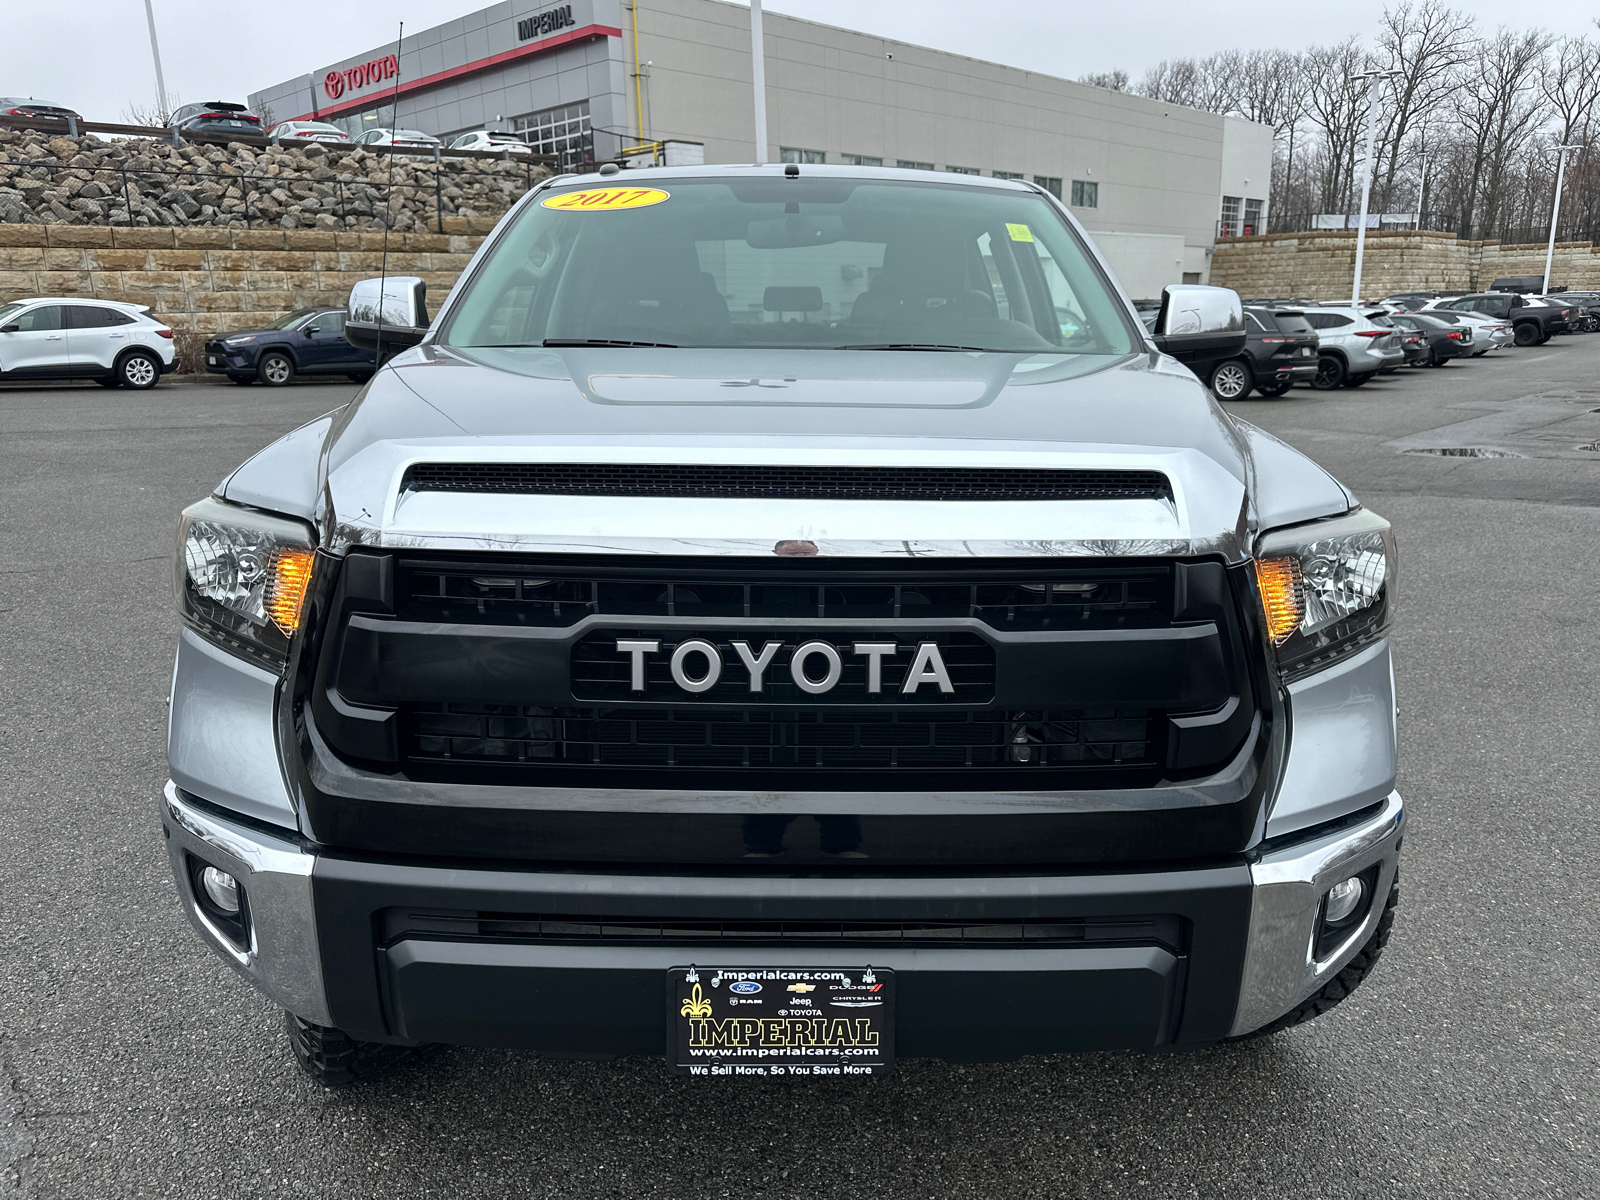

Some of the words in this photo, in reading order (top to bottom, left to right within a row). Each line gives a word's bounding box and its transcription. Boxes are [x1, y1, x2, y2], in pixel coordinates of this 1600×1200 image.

[517, 5, 575, 41] IMPERIAL
[342, 54, 400, 90] TOYOTA
[558, 190, 652, 207] 2017
[615, 639, 955, 694] TOYOTA
[717, 970, 845, 982] Imperialcars.com
[736, 983, 756, 992] Ford
[789, 997, 812, 1006] Jeep
[689, 1018, 879, 1047] IMPERIAL
[689, 1047, 879, 1057] www.imperialcars.com
[690, 1066, 708, 1075] We
[711, 1066, 732, 1075] Sell
[735, 1066, 767, 1076] More,
[770, 1066, 785, 1075] So
[789, 1066, 810, 1075] You
[813, 1066, 841, 1075] Save
[844, 1066, 872, 1075] More
